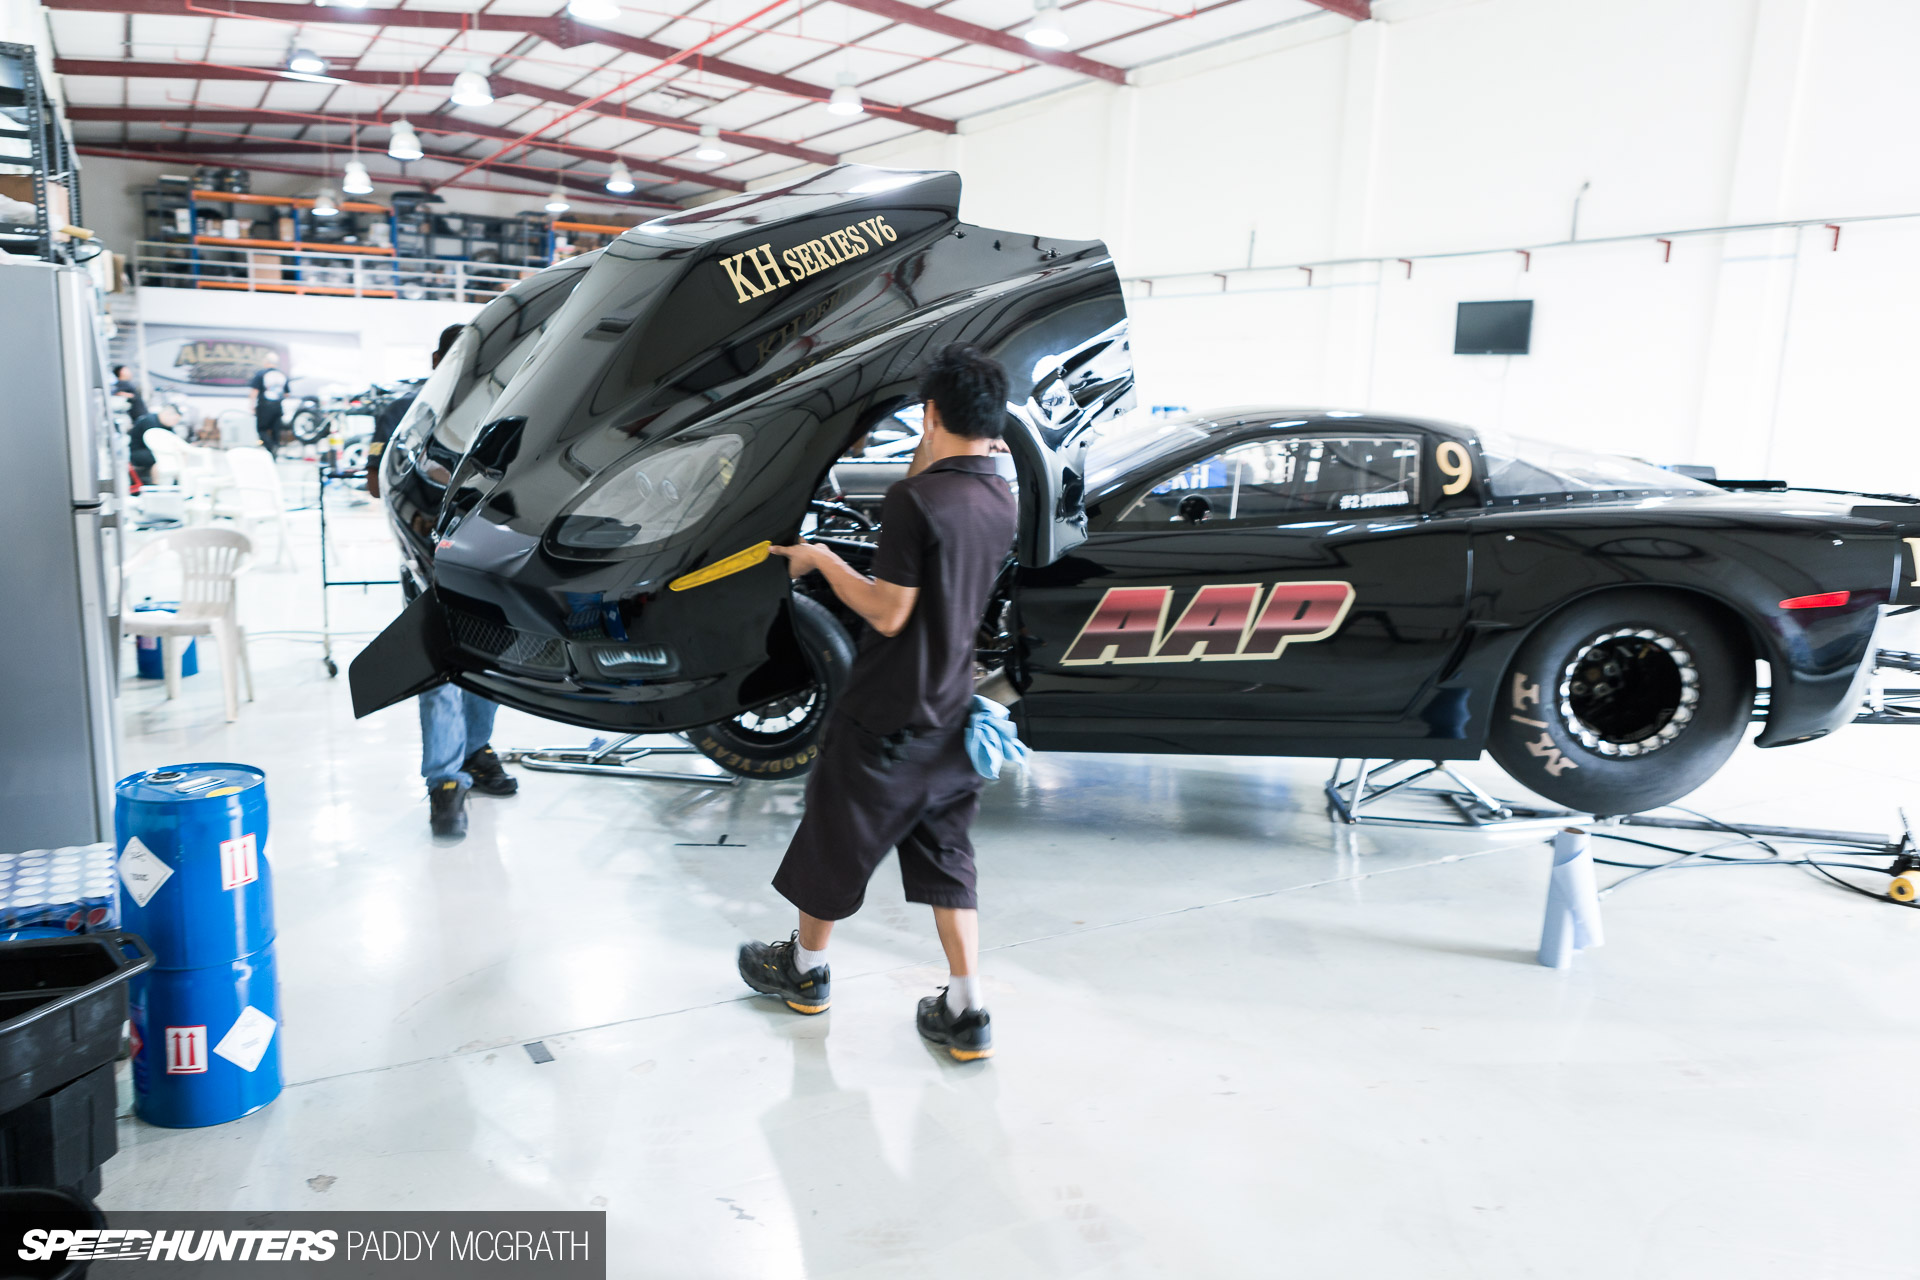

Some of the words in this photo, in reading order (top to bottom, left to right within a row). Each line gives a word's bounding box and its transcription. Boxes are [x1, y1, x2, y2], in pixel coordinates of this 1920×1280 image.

[719, 243, 790, 304] KH
[783, 224, 869, 282] SERIES
[858, 215, 897, 247] V6
[1340, 494, 1360, 510] #2
[1436, 441, 1472, 495] 9
[1059, 580, 1356, 667] AAP
